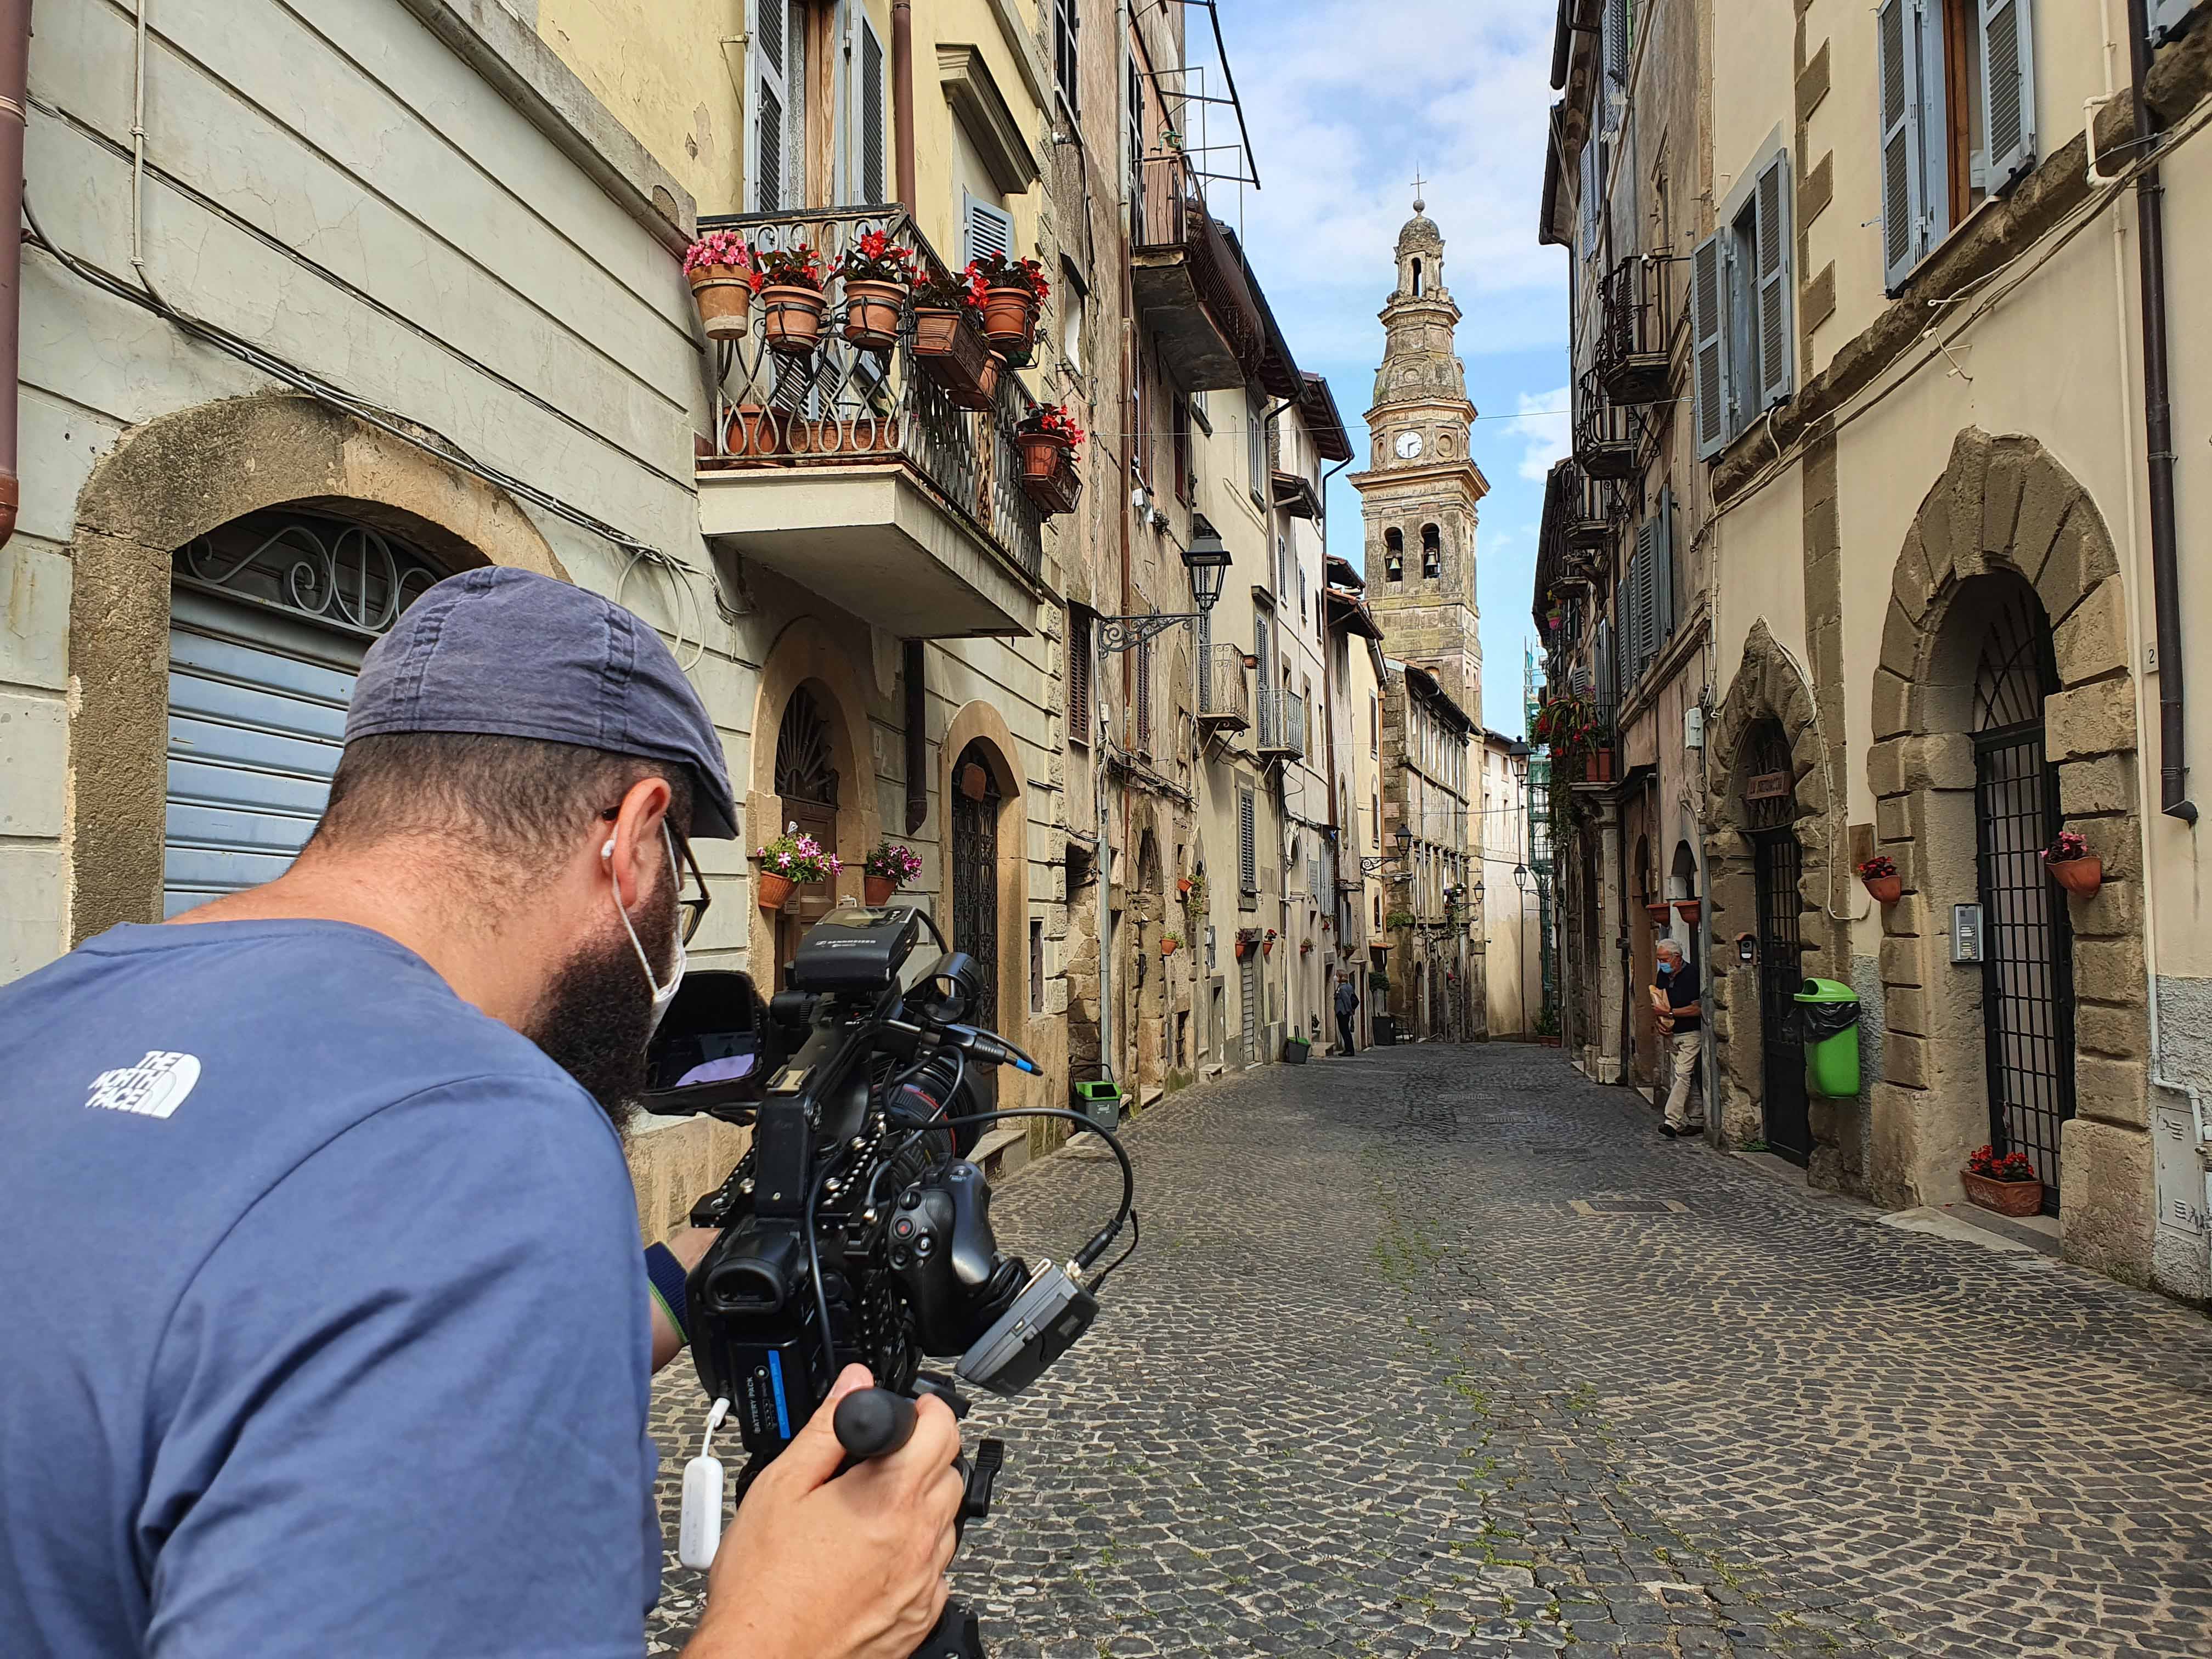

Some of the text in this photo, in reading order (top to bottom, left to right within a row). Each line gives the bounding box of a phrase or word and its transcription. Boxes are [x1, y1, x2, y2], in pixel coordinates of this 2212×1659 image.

[2148, 648, 2155, 664] 2
[135, 1050, 185, 1070] THE
[88, 1068, 167, 1090] NORTH
[85, 1086, 149, 1111] FACE
[921, 1238, 929, 1249] 6
[747, 1376, 761, 1434] BATTERY PACK
